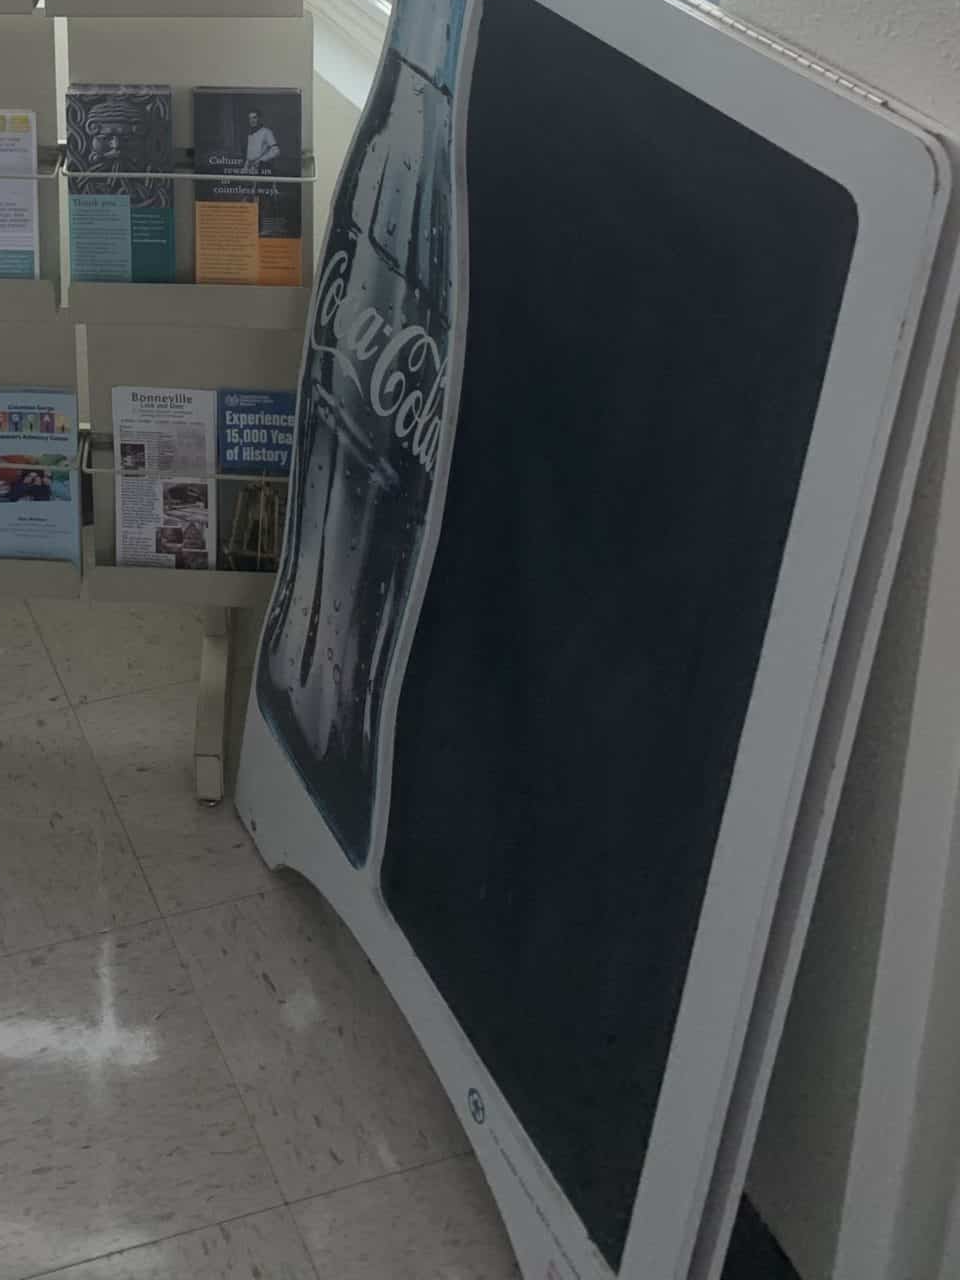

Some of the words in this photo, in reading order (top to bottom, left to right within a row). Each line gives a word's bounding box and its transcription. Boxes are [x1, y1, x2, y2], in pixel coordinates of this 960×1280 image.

[208, 154, 247, 166] Cultur
[131, 391, 193, 405] Bonneville
[225, 411, 296, 427] Experience
[226, 429, 268, 445] 15,000
[270, 430, 294, 444] Yea
[226, 449, 240, 461] of
[242, 449, 288, 465] History
